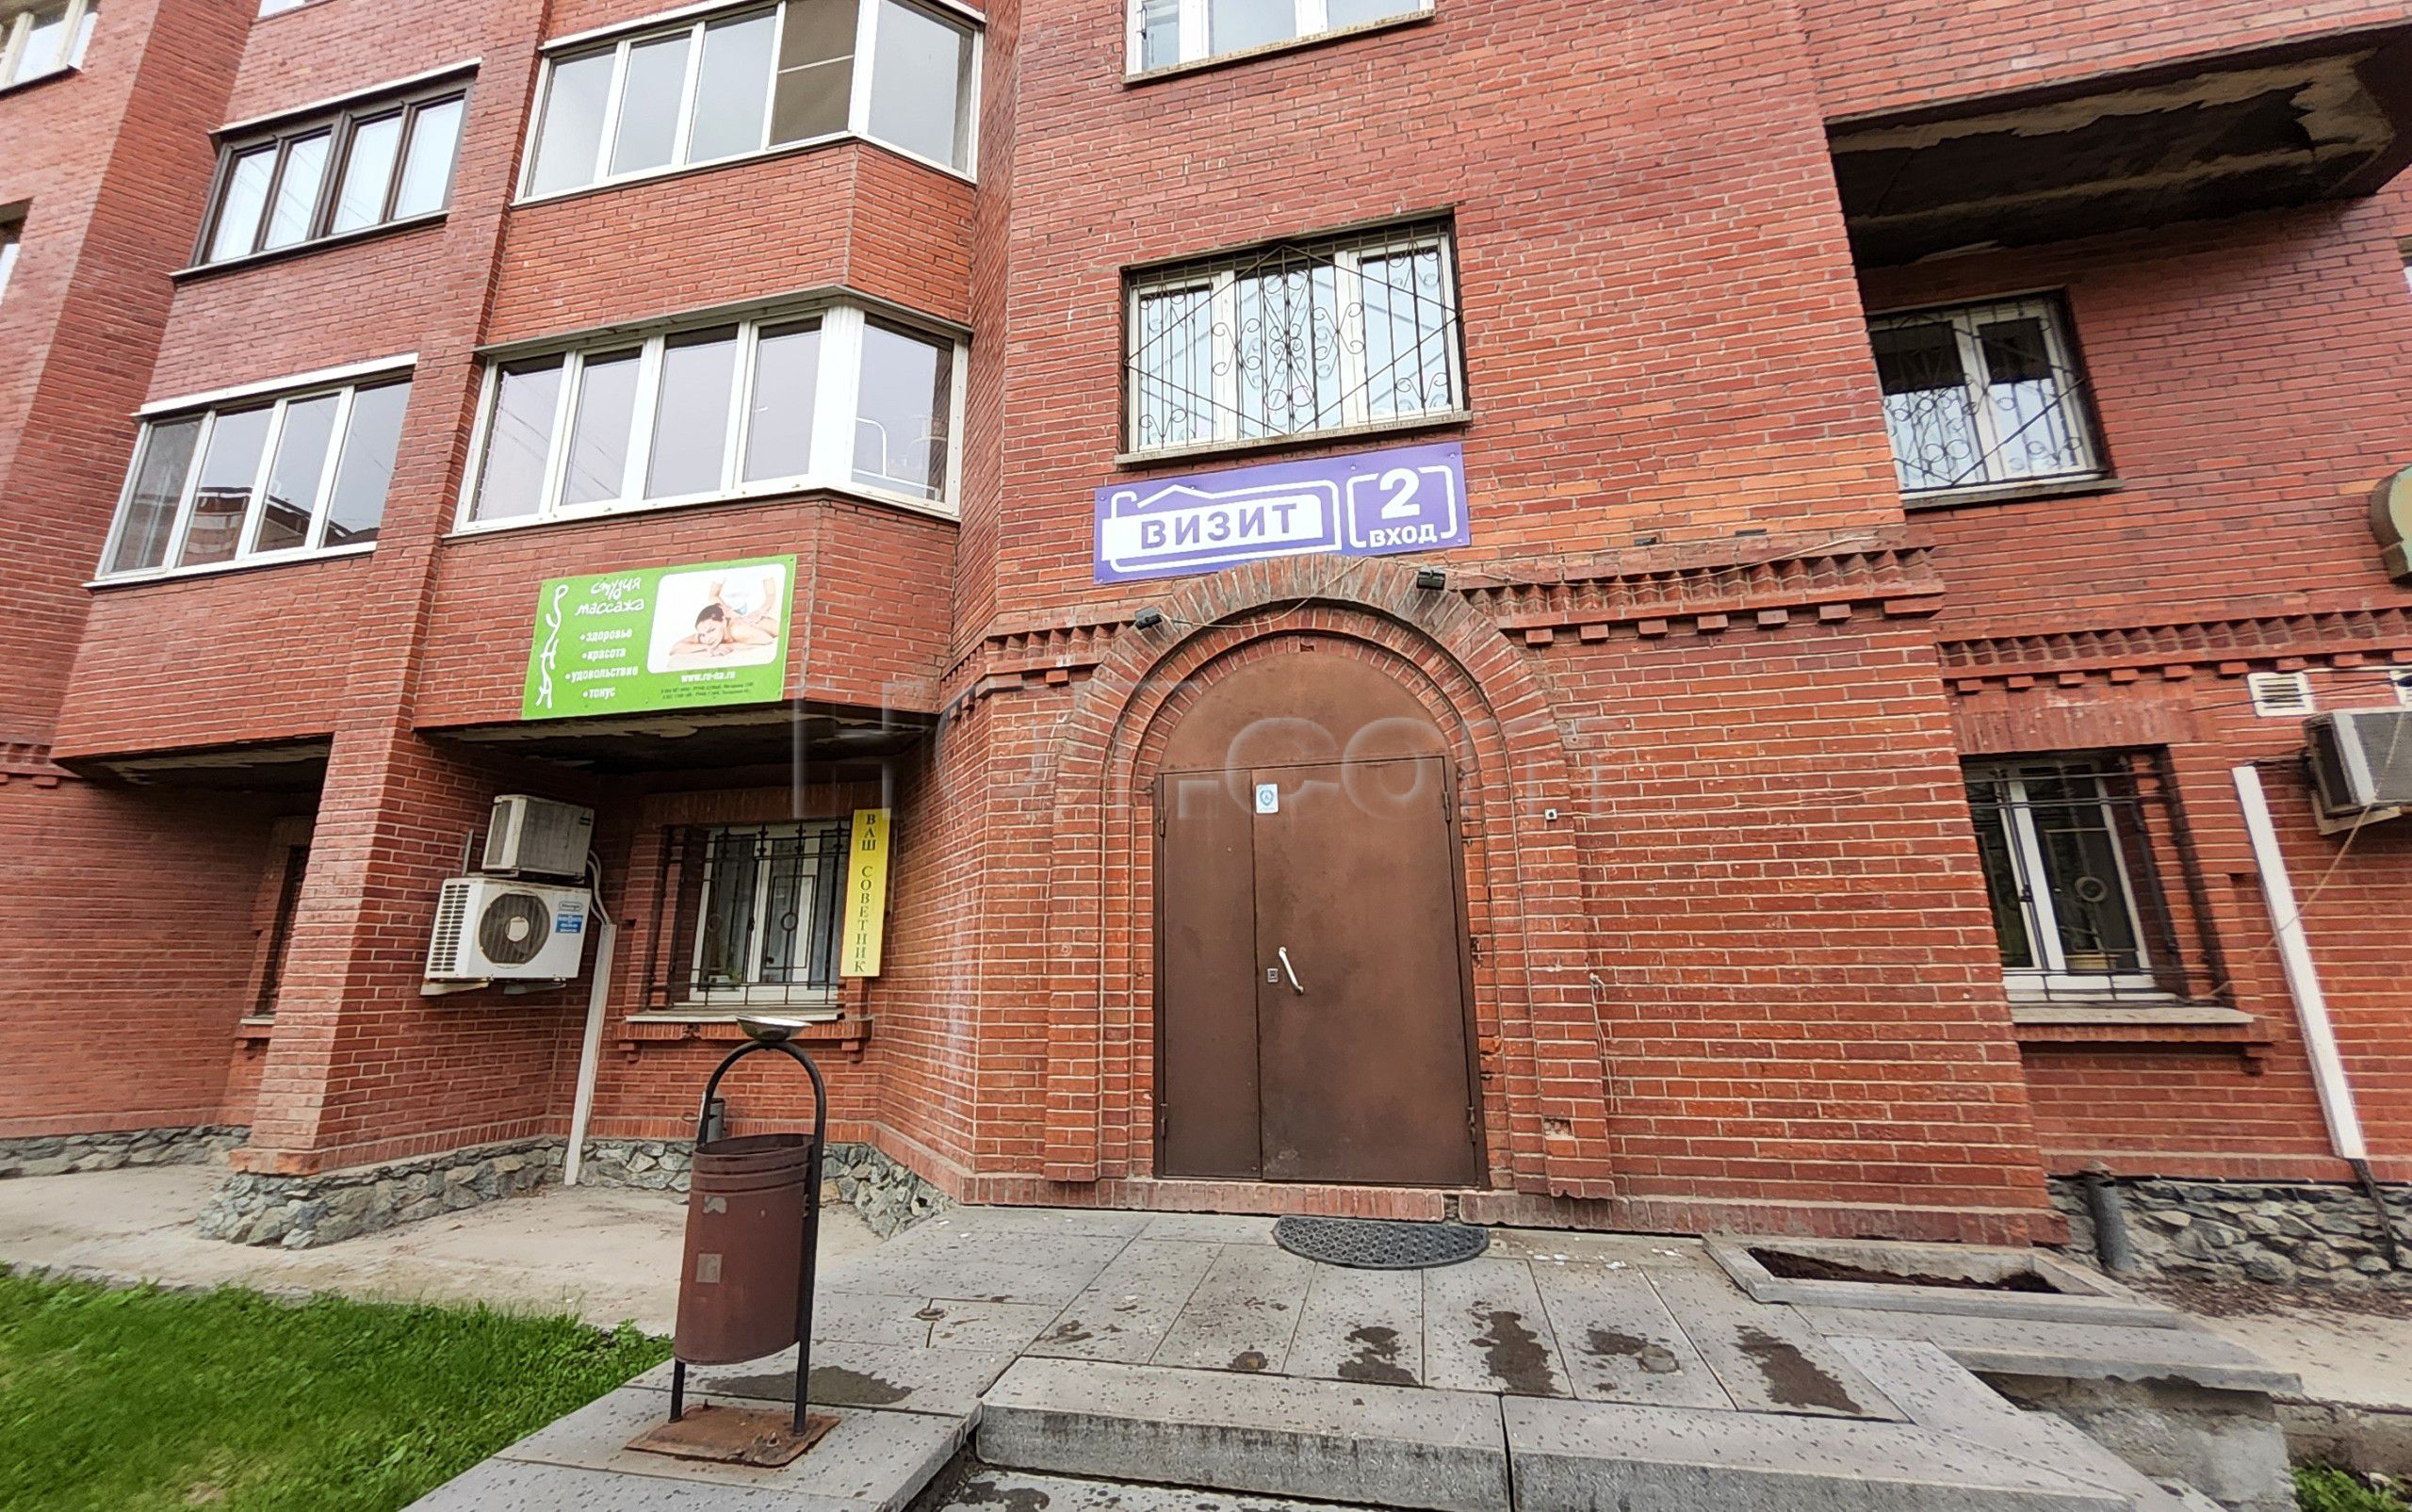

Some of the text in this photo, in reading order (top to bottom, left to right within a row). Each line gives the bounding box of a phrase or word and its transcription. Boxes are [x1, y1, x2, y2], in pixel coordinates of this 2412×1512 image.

[1378, 467, 1421, 520] 2
[1141, 503, 1297, 549] ВИЗИТ
[1369, 523, 1438, 548] ВХОД
[575, 598, 644, 616] массажа
[587, 648, 626, 661] красота
[571, 666, 638, 683] удовольствие
[589, 687, 615, 700] тонус
[855, 814, 876, 972] ВАШ СОВЕТНИК
